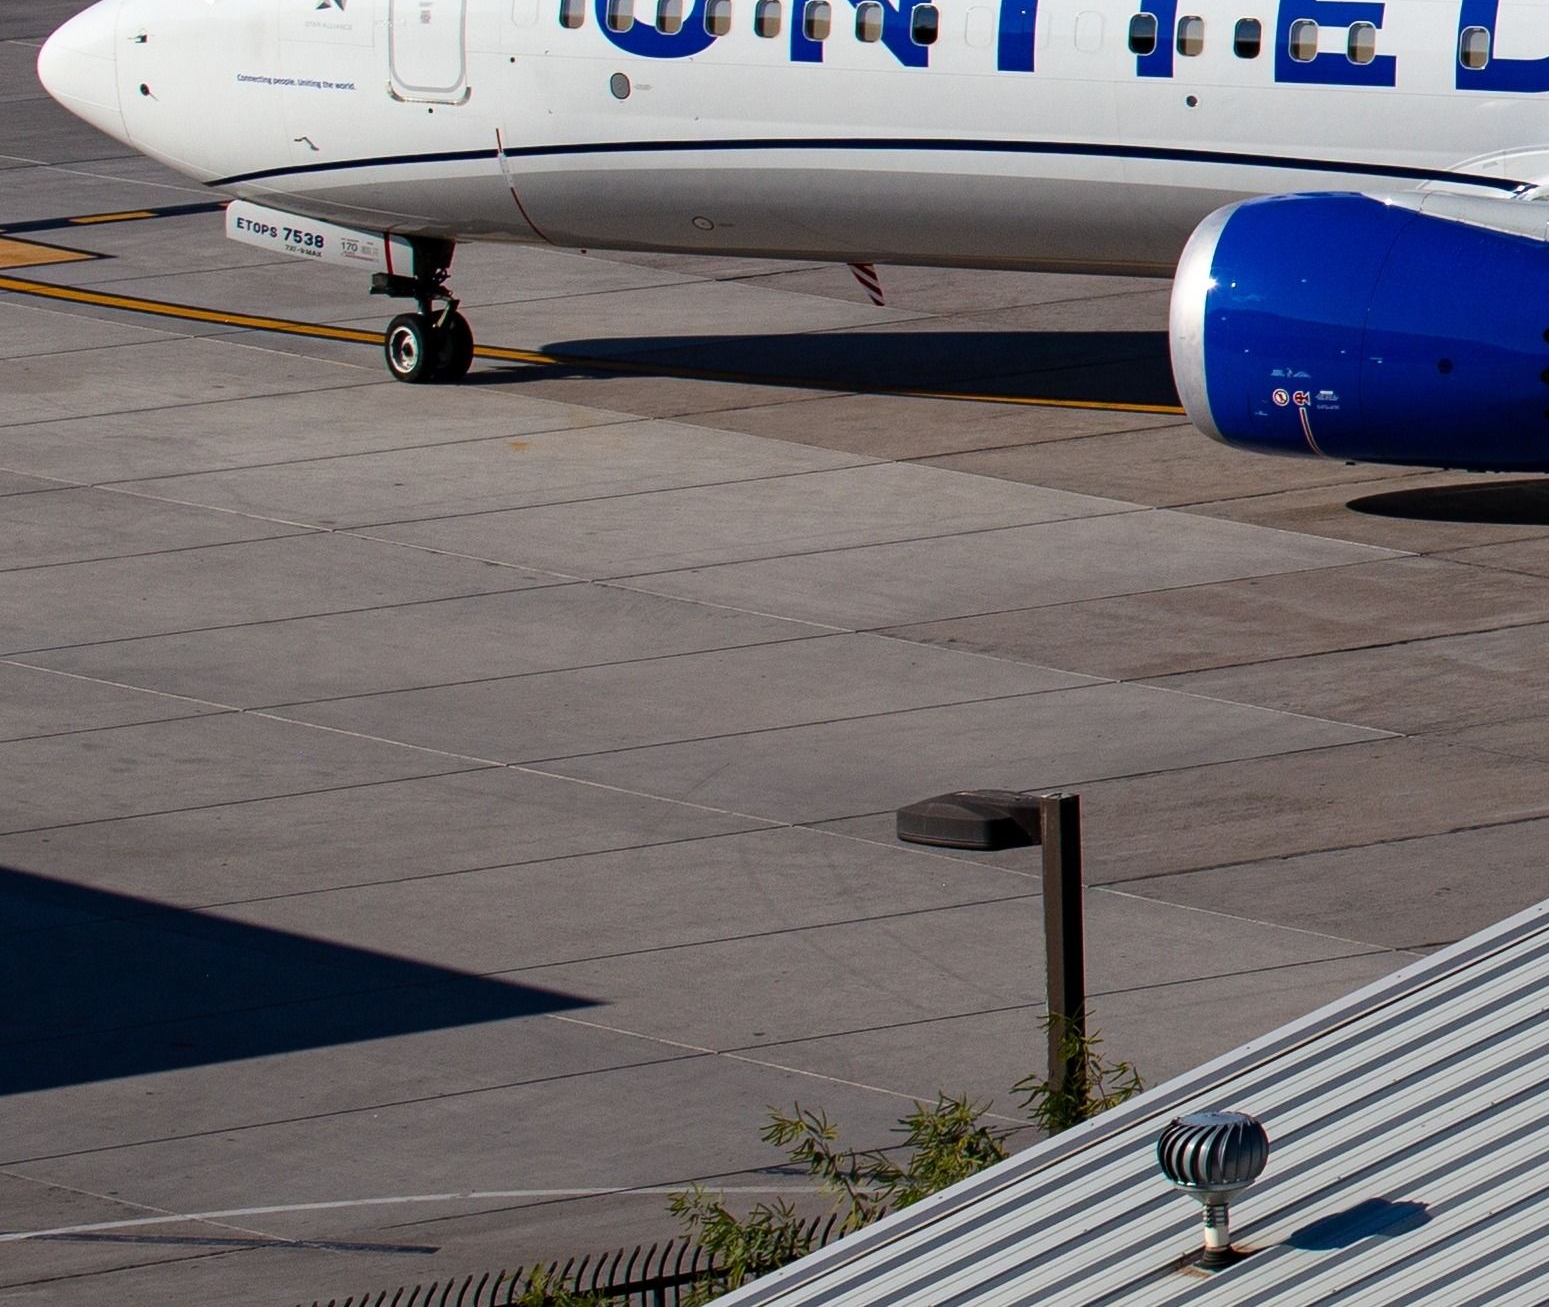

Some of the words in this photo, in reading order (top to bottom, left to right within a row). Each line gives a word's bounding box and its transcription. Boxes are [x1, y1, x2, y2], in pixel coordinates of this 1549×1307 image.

[236, 73, 272, 85] Connecting
[297, 79, 322, 89] Uniting
[322, 81, 333, 89] the
[236, 217, 279, 238] ETOPS
[282, 227, 325, 249] 7538
[340, 241, 359, 253] 170
